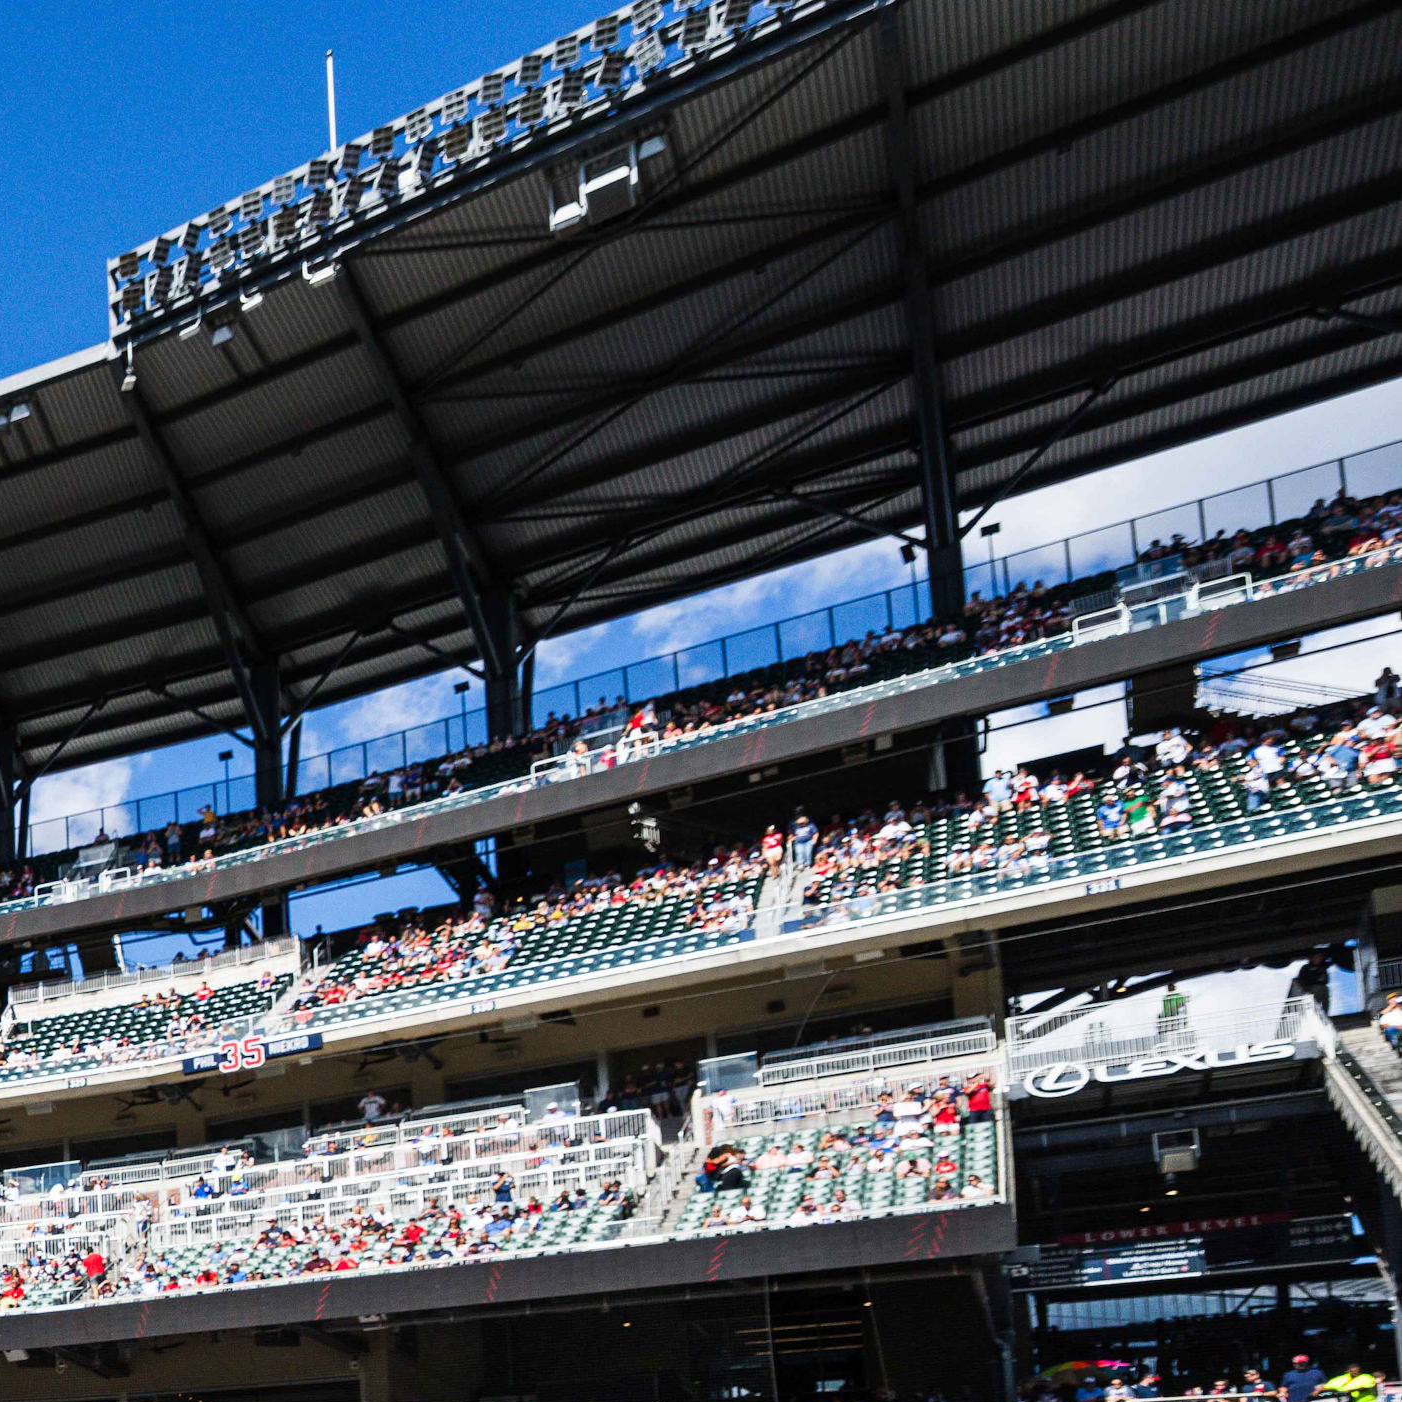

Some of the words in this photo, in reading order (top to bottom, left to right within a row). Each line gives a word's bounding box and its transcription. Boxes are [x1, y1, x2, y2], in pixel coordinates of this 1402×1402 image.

[194, 1056, 217, 1069] PHIL
[219, 1035, 265, 1073] 35
[1095, 1038, 1296, 1083] LEXUS
[1084, 1224, 1168, 1242] LOWER
[1183, 1214, 1263, 1232] LEVEL
